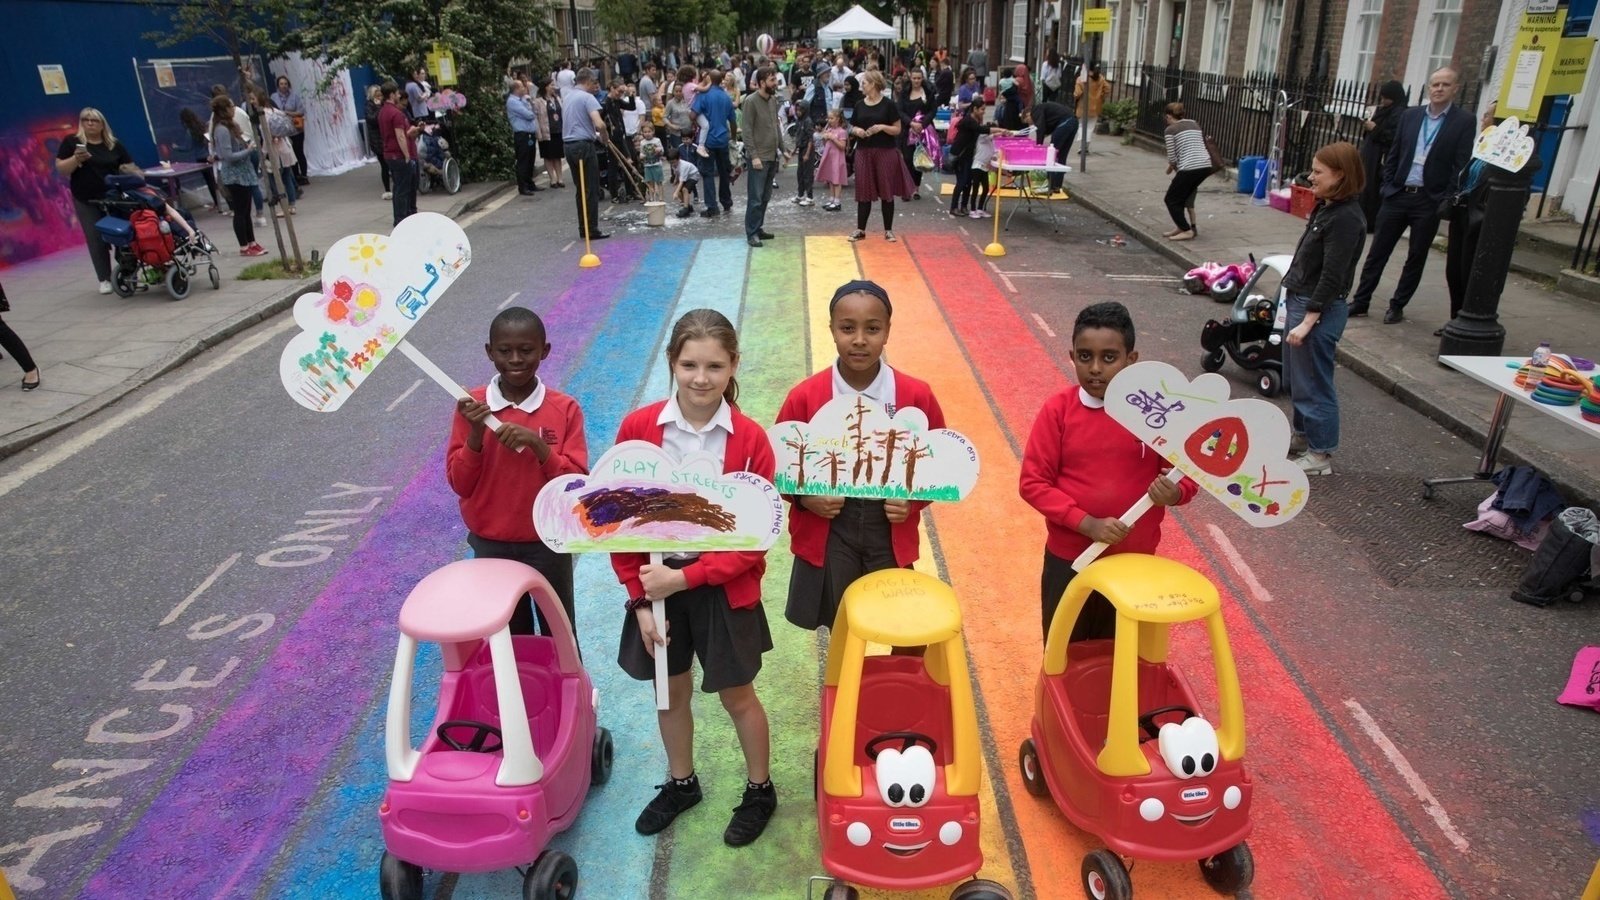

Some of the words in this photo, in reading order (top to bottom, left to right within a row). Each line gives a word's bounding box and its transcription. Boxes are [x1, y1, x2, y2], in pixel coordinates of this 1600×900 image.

[1527, 16, 1556, 24] WARNING
[1560, 57, 1585, 66] WARNING
[613, 459, 659, 478] PLAY
[671, 471, 737, 499] STREETS
[254, 482, 393, 568] ONLY
[771, 495, 783, 535] DANIEL
[863, 577, 921, 592] EAGLE
